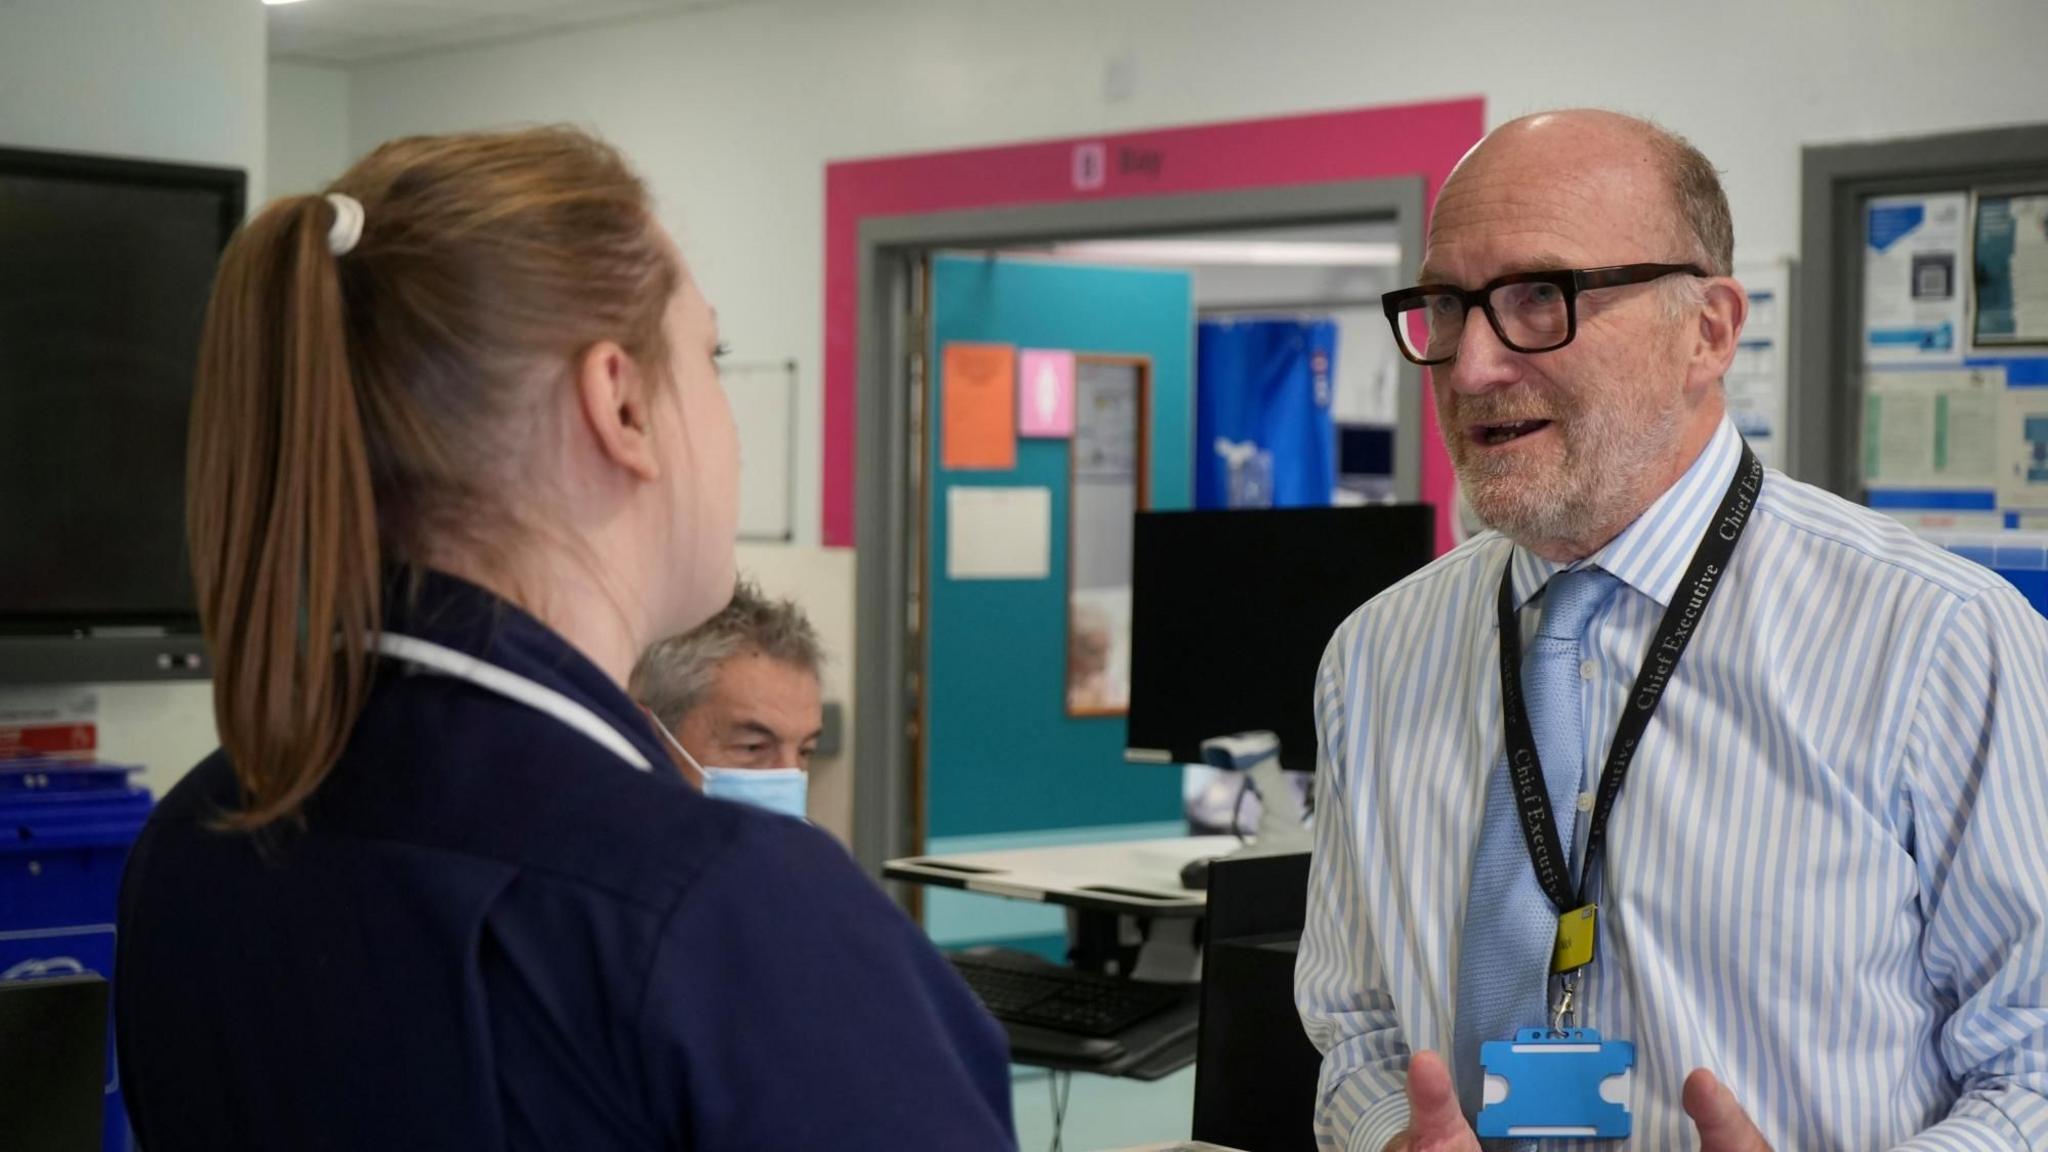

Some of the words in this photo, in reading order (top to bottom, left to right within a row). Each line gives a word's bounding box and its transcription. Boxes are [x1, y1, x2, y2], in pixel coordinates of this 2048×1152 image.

[1118, 145, 1165, 182] Bay
[1719, 488, 1752, 541] Chief
[1636, 651, 1673, 711] Chief
[1661, 563, 1719, 652] Executive
[1514, 748, 1543, 803] Chief
[1527, 806, 1565, 906] Executive
